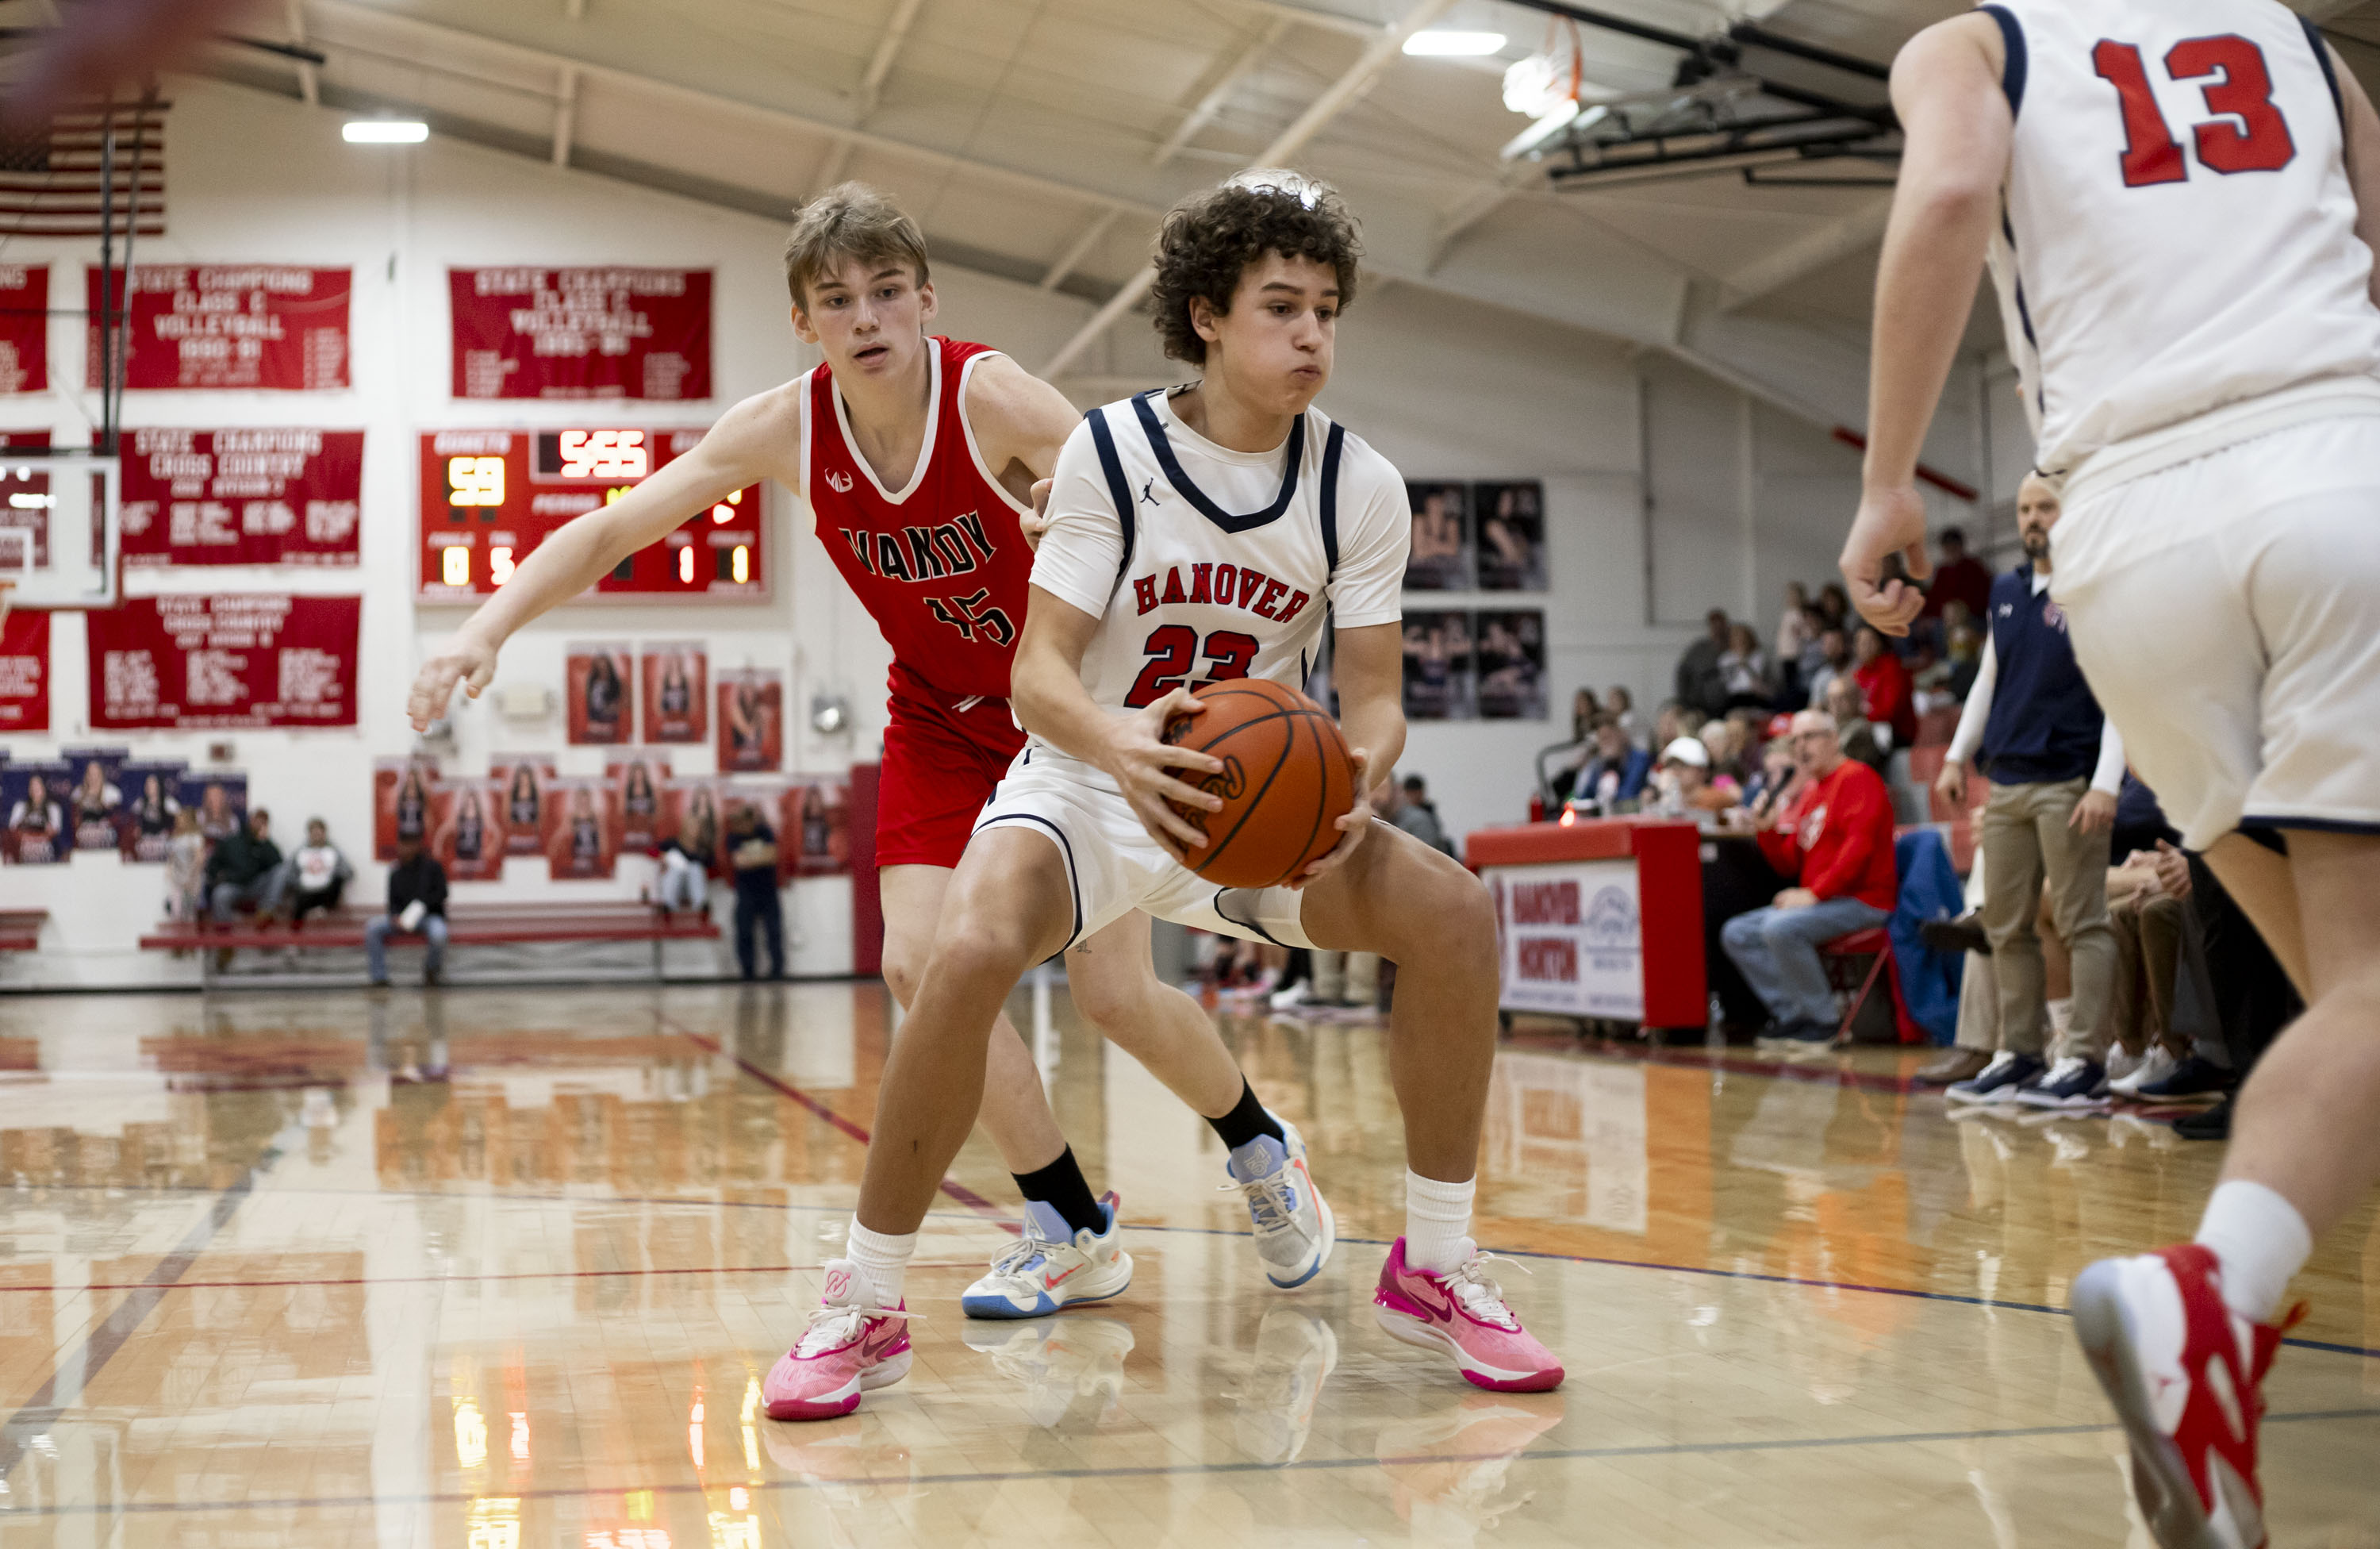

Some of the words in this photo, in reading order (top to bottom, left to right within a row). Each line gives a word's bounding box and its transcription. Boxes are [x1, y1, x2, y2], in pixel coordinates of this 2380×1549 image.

[2091, 33, 2297, 187] 13
[449, 457, 505, 505] 59
[1134, 563, 1310, 623] HANOVER
[1123, 625, 1260, 709] 23
